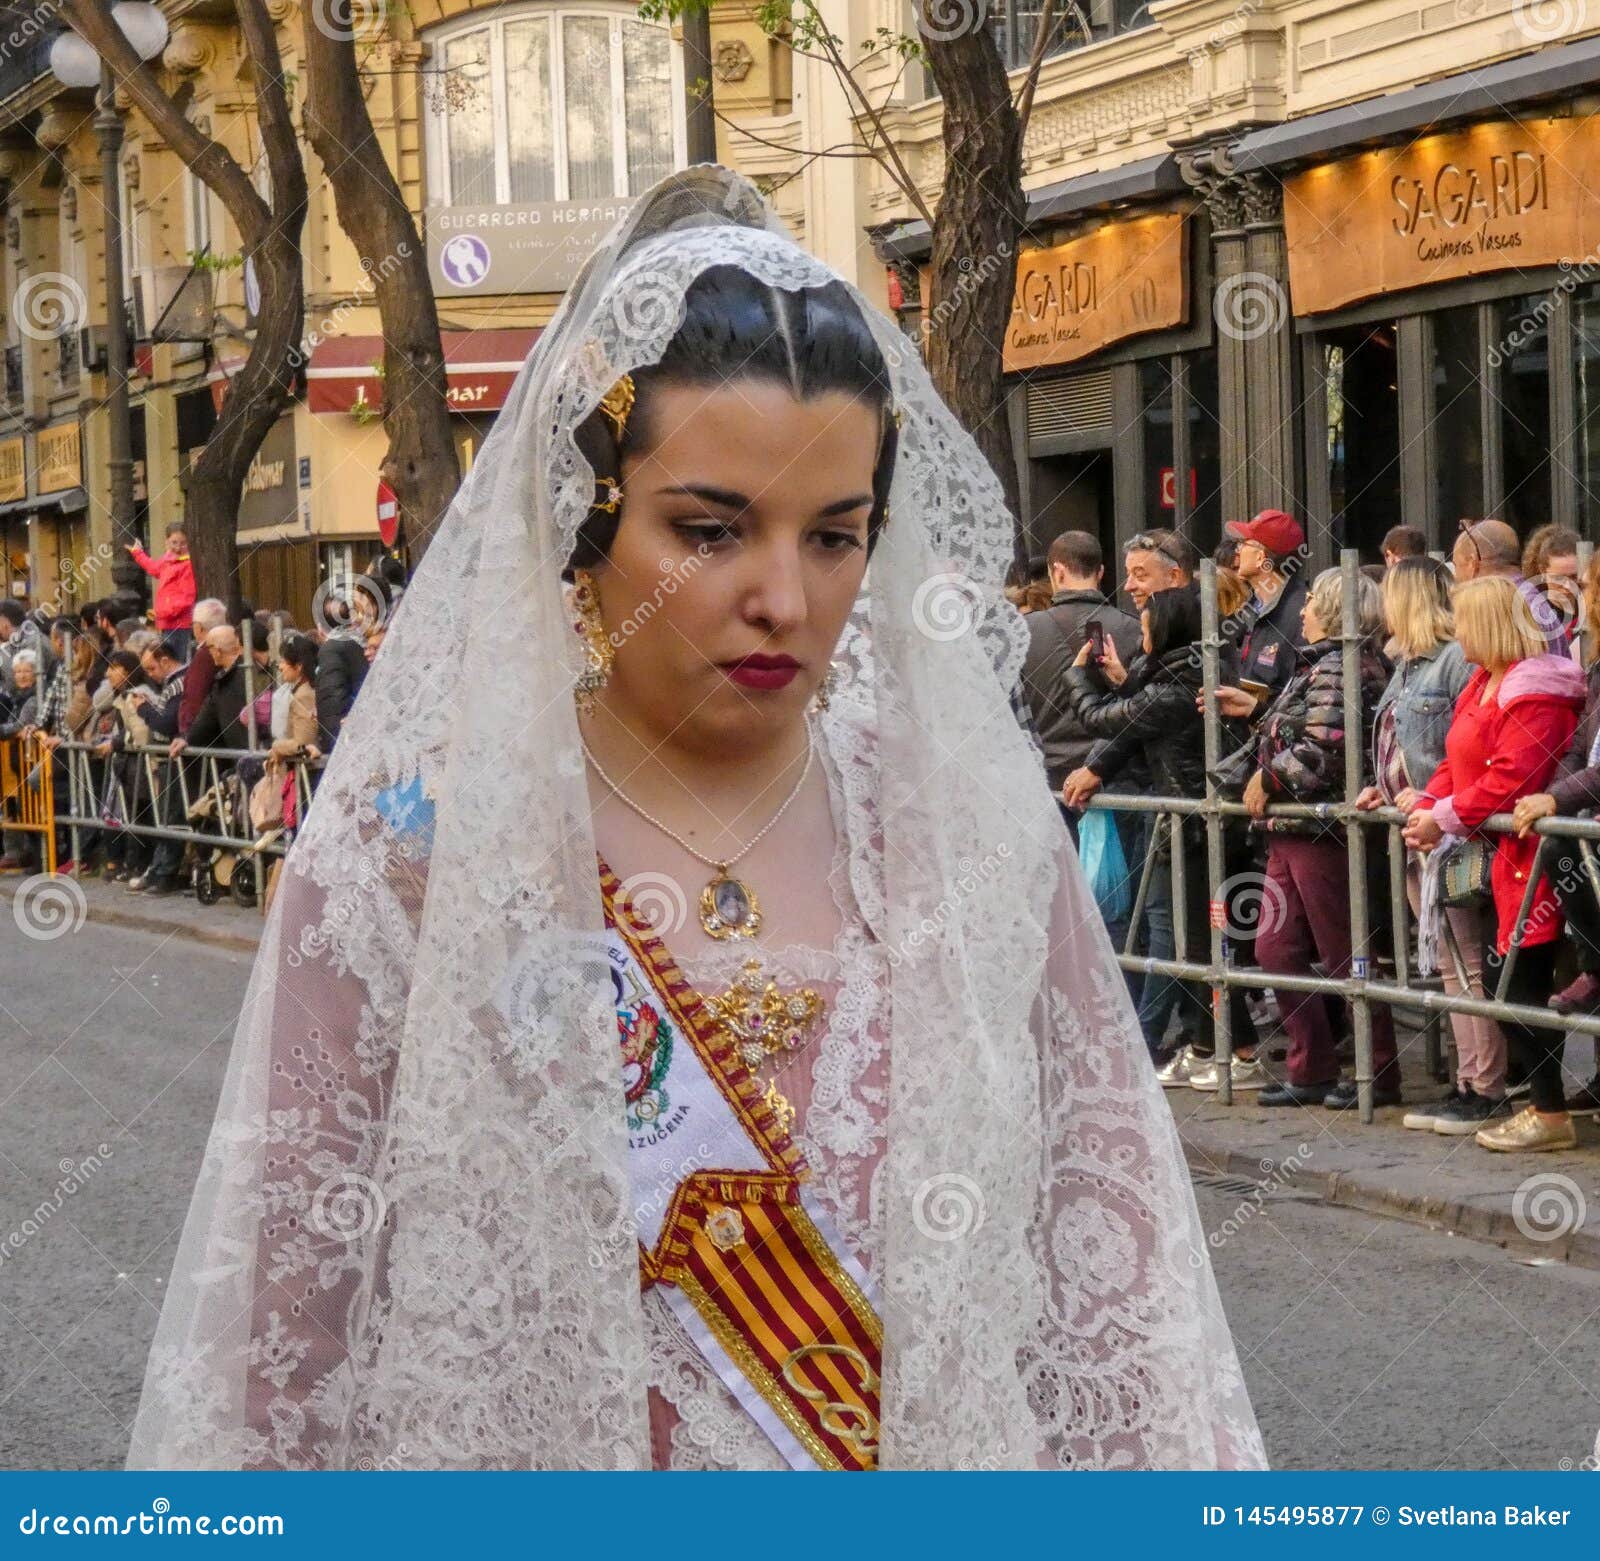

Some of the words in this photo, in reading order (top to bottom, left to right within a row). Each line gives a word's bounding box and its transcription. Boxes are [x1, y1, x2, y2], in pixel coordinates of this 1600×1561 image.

[1392, 151, 1549, 237] SAGARDI
[440, 211, 541, 229] GUERRERO
[1417, 238, 1474, 261] Cocineros
[1477, 222, 1522, 251] Vascos
[1012, 262, 1097, 322] AGARDI
